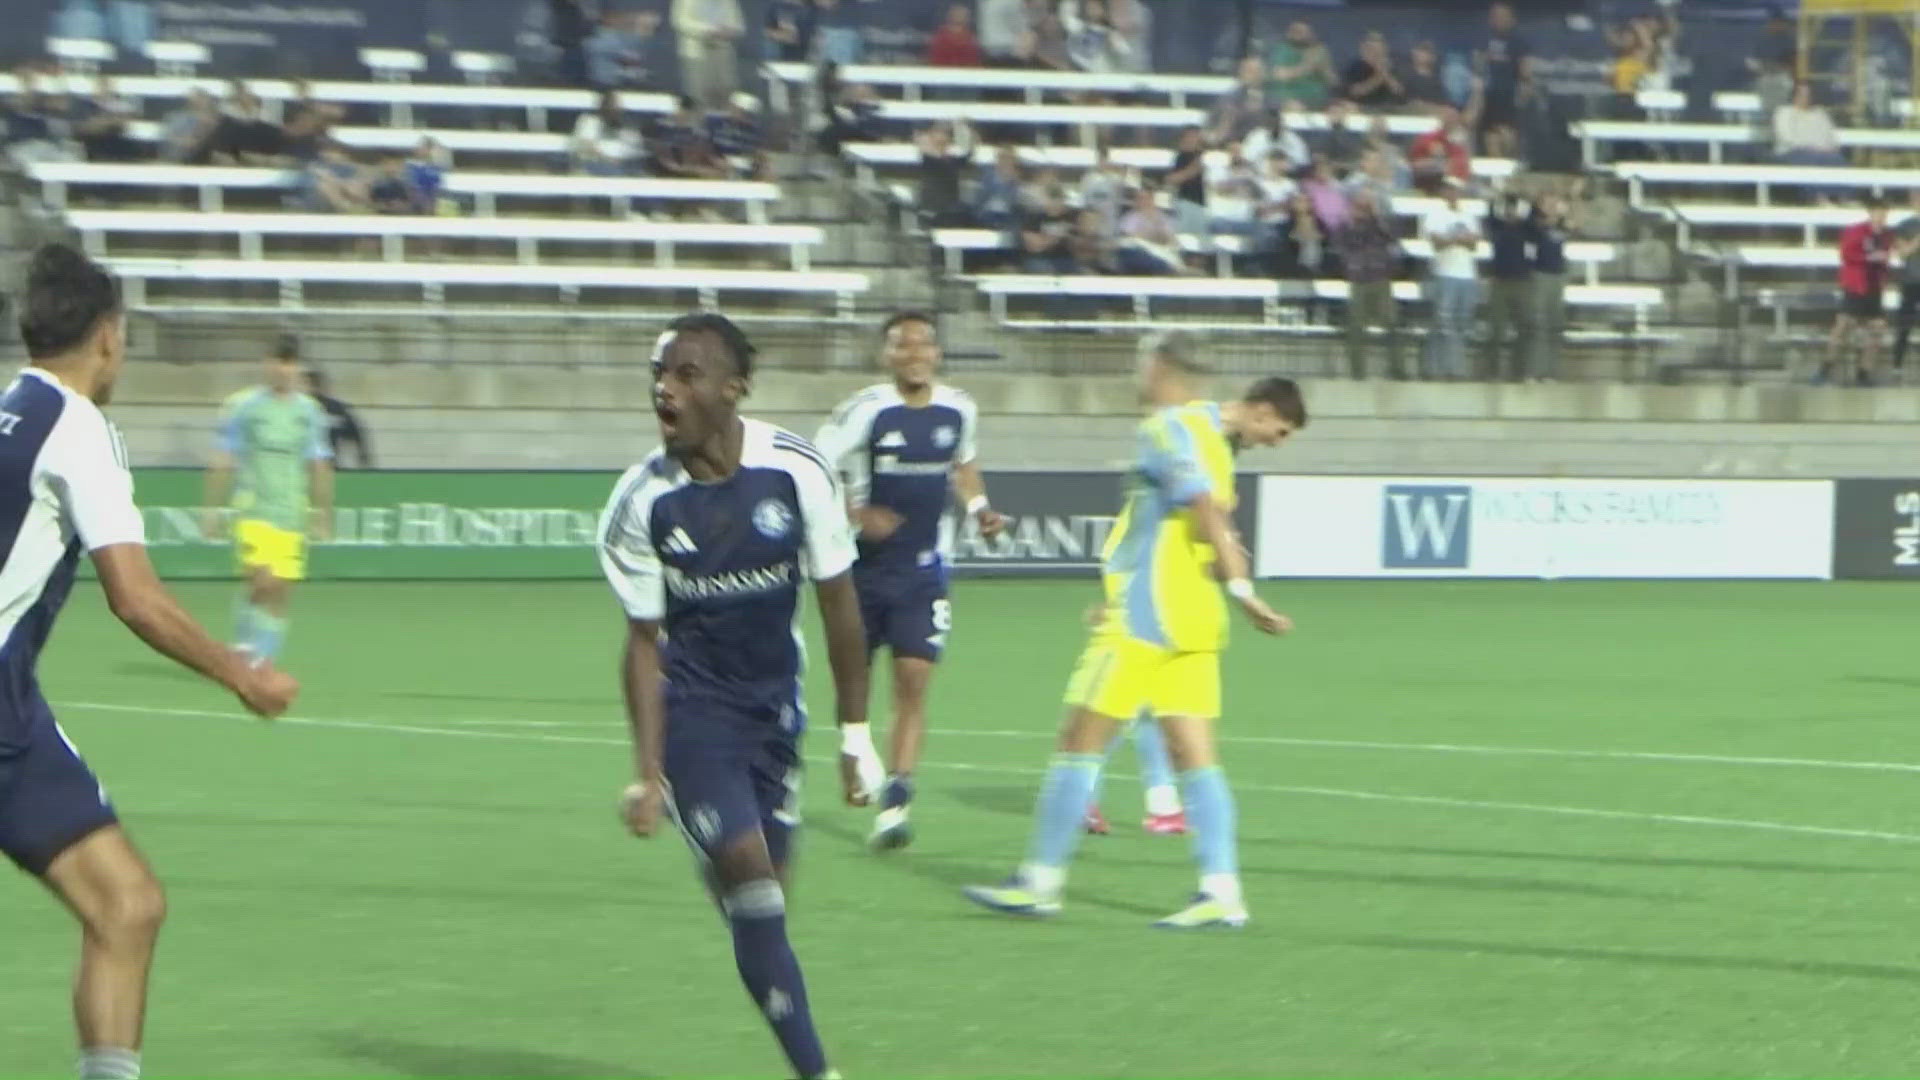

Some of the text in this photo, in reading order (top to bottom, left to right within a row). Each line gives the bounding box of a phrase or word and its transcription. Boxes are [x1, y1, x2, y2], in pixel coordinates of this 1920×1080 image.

[398, 502, 600, 545] HOSPITA
[955, 514, 1120, 558] ASANT
[1388, 494, 1468, 560] W
[1893, 492, 1920, 566] MLS
[931, 599, 951, 630] 8
